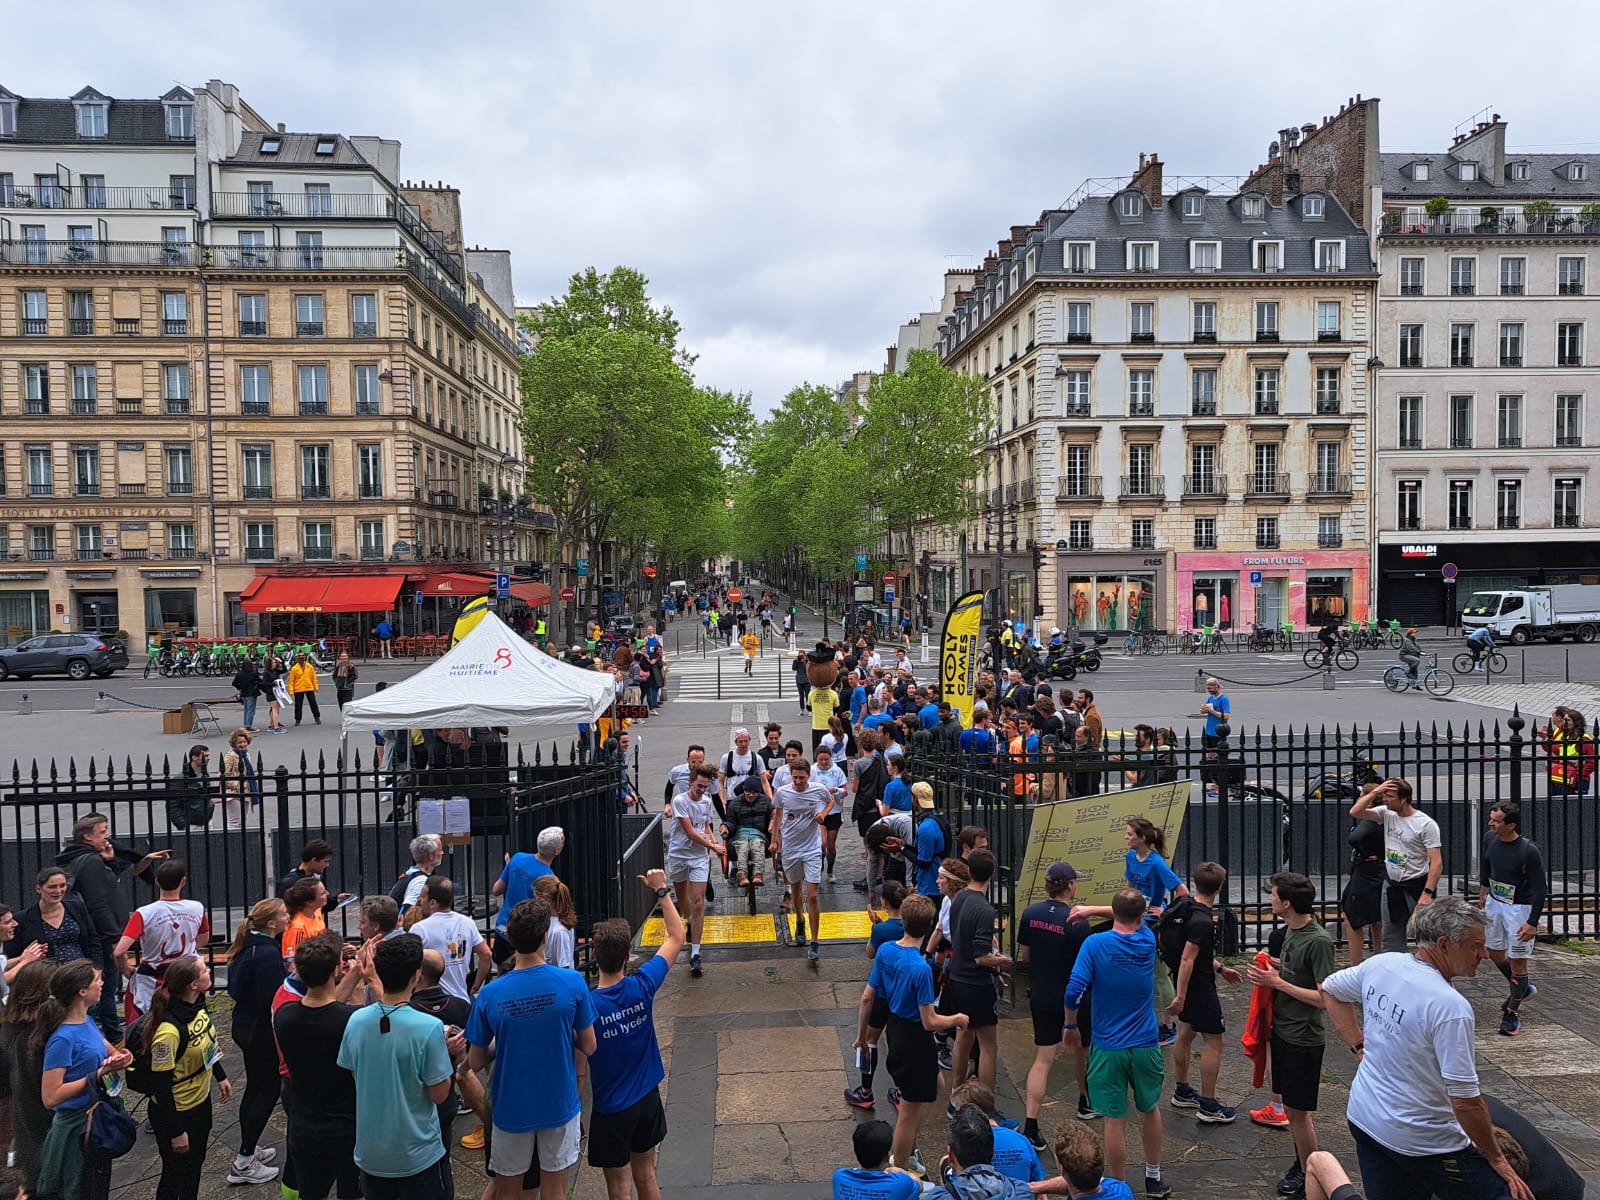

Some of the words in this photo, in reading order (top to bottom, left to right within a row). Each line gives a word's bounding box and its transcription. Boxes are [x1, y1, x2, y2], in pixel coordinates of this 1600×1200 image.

[130, 507, 171, 517] PLAZA
[1402, 545, 1437, 553] UBALDI
[1243, 557, 1268, 565] FROM
[1270, 556, 1304, 565] FUTURE
[945, 631, 958, 695] HOLY
[957, 633, 968, 696] GAMES
[1029, 919, 1065, 935] EMMANUEL
[600, 1001, 645, 1026] Internat
[602, 1028, 618, 1039] du
[620, 1014, 648, 1034] lycée
